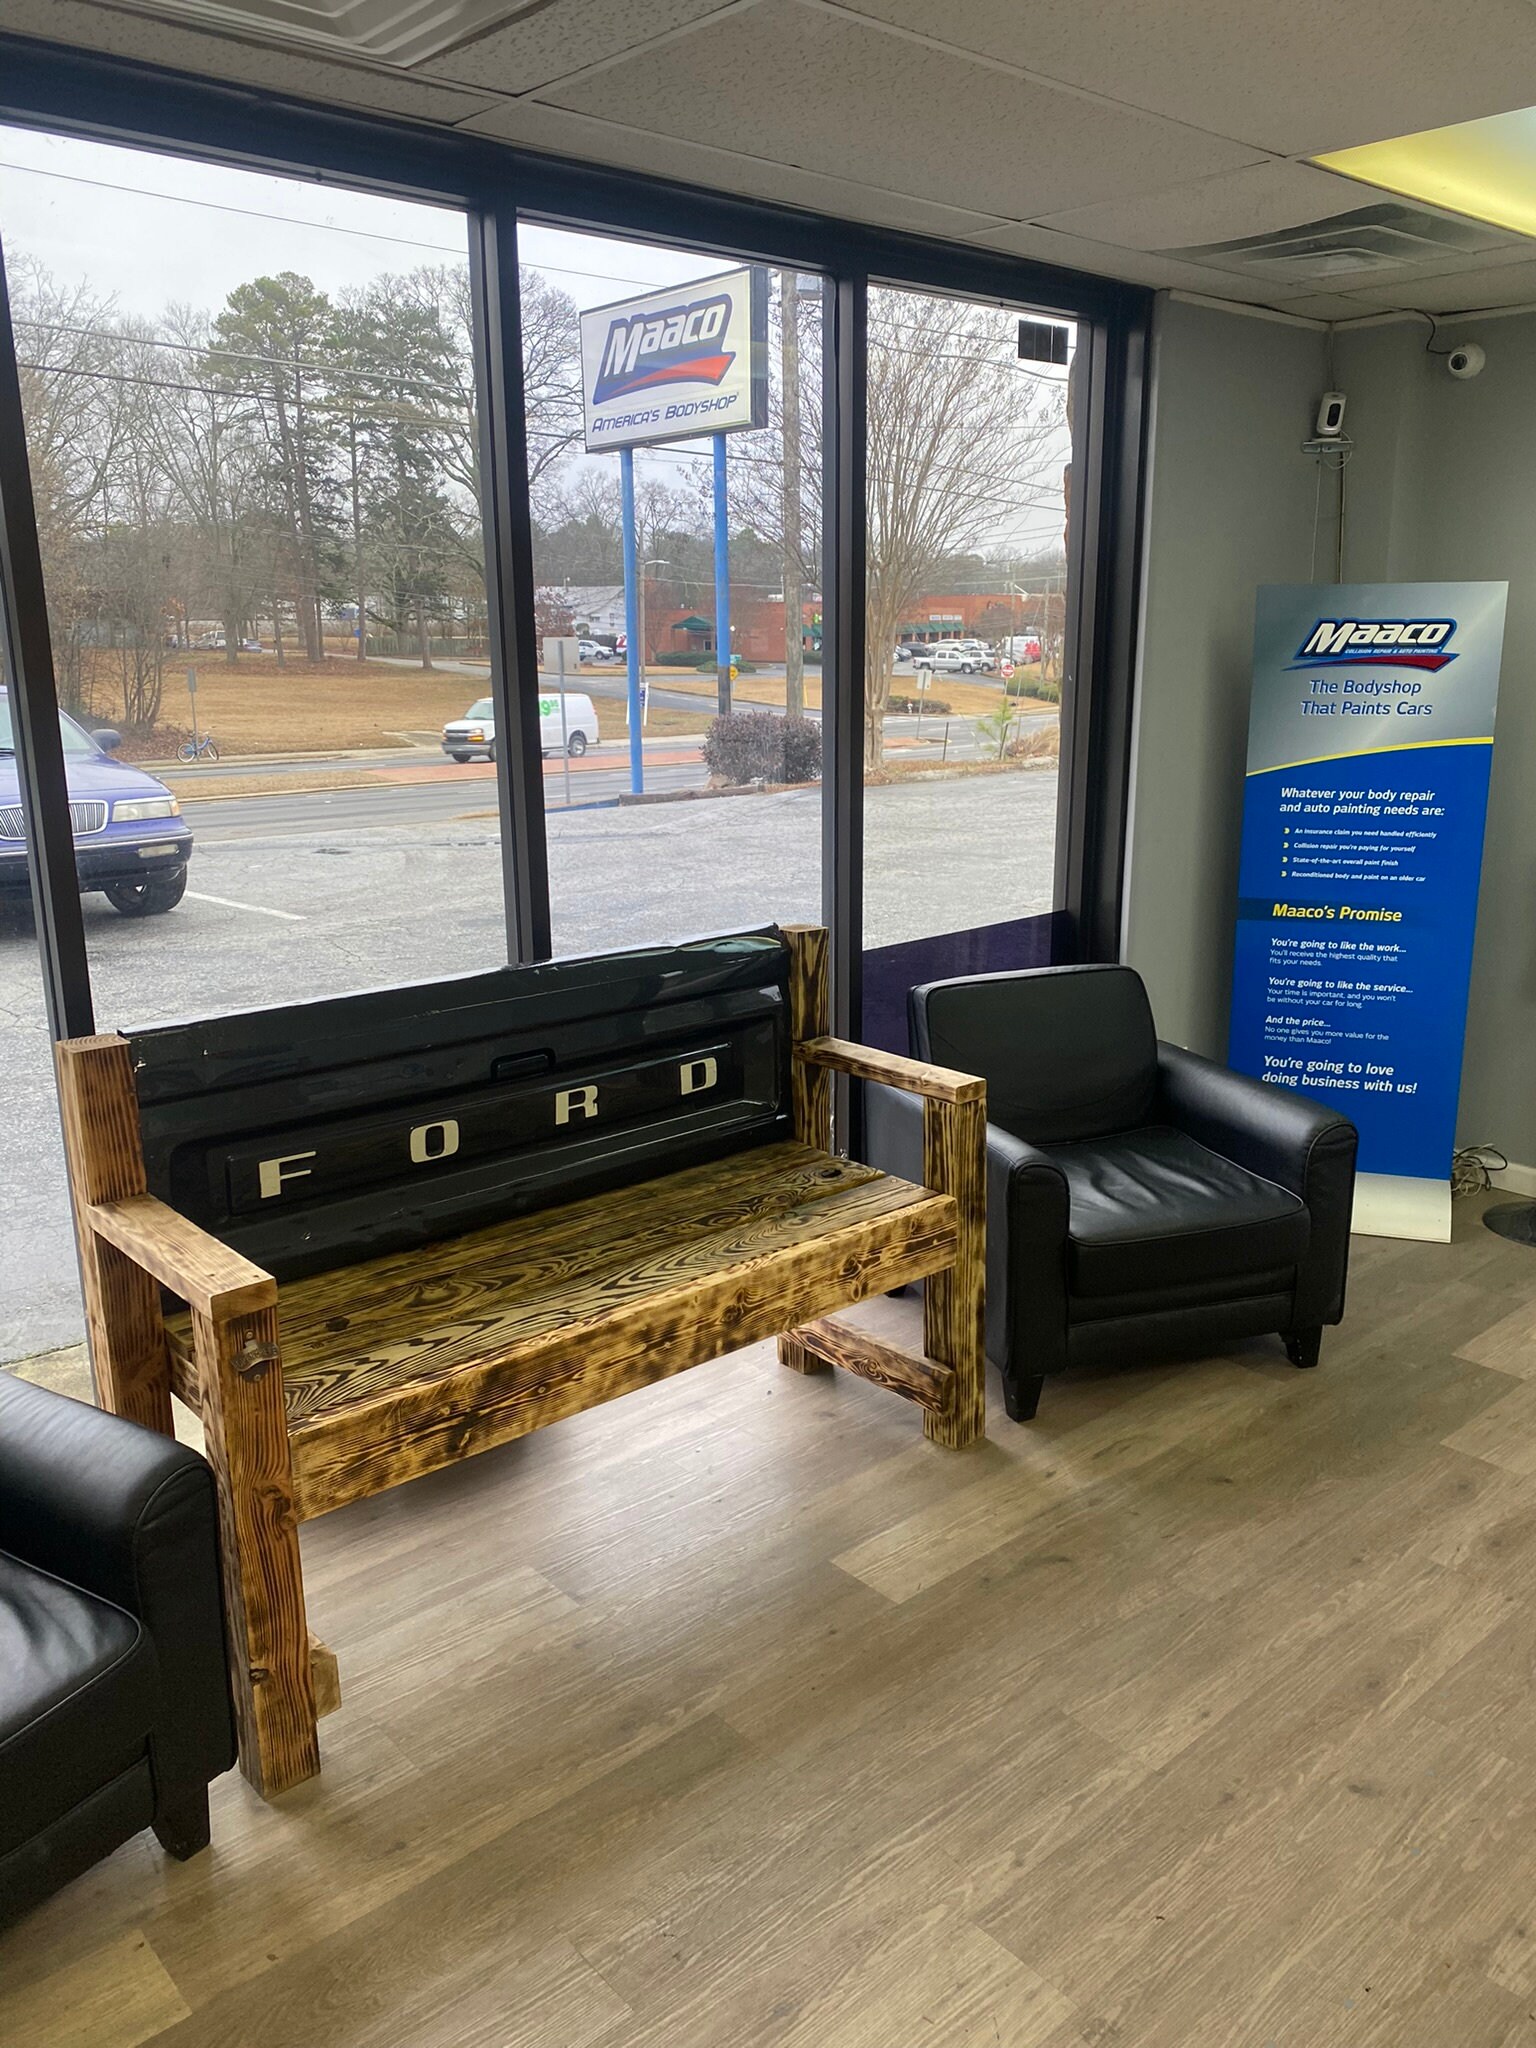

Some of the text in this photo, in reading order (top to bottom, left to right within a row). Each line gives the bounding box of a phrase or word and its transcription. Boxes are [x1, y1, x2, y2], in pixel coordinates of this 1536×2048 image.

[603, 303, 727, 377] Maaco
[665, 395, 738, 420] BODYSHOP
[1304, 623, 1450, 653] Maaco
[1310, 680, 1422, 696] The Bodyshop
[1301, 701, 1433, 715] That Paints Cars
[1281, 787, 1435, 803] Whatever your body repair
[1279, 802, 1445, 816] and auto painting needs are:
[1405, 831, 1437, 839] efficiently
[1292, 856, 1341, 864] State-of-the-art
[1291, 870, 1334, 879] Reconditioned
[1335, 872, 1350, 880] body
[1272, 903, 1403, 922] Maaco's Promise
[1271, 938, 1298, 947] You're
[1300, 940, 1325, 950] going
[1340, 941, 1356, 950] like
[1359, 942, 1374, 951] the
[1376, 944, 1407, 953] work...
[1329, 952, 1356, 960] highest
[1357, 953, 1382, 962] quality
[1267, 987, 1283, 995] Your
[1268, 976, 1296, 986] You're
[1297, 979, 1323, 989] going
[1337, 980, 1353, 990] like
[1356, 982, 1371, 990] the
[1373, 984, 1414, 993] service...
[1346, 1001, 1363, 1009] long.
[1265, 1015, 1331, 1027] And the price...
[1264, 1056, 1394, 1076] You're going to love
[1262, 1071, 1418, 1094] doing business with us!
[258, 1057, 717, 1199] FORD
